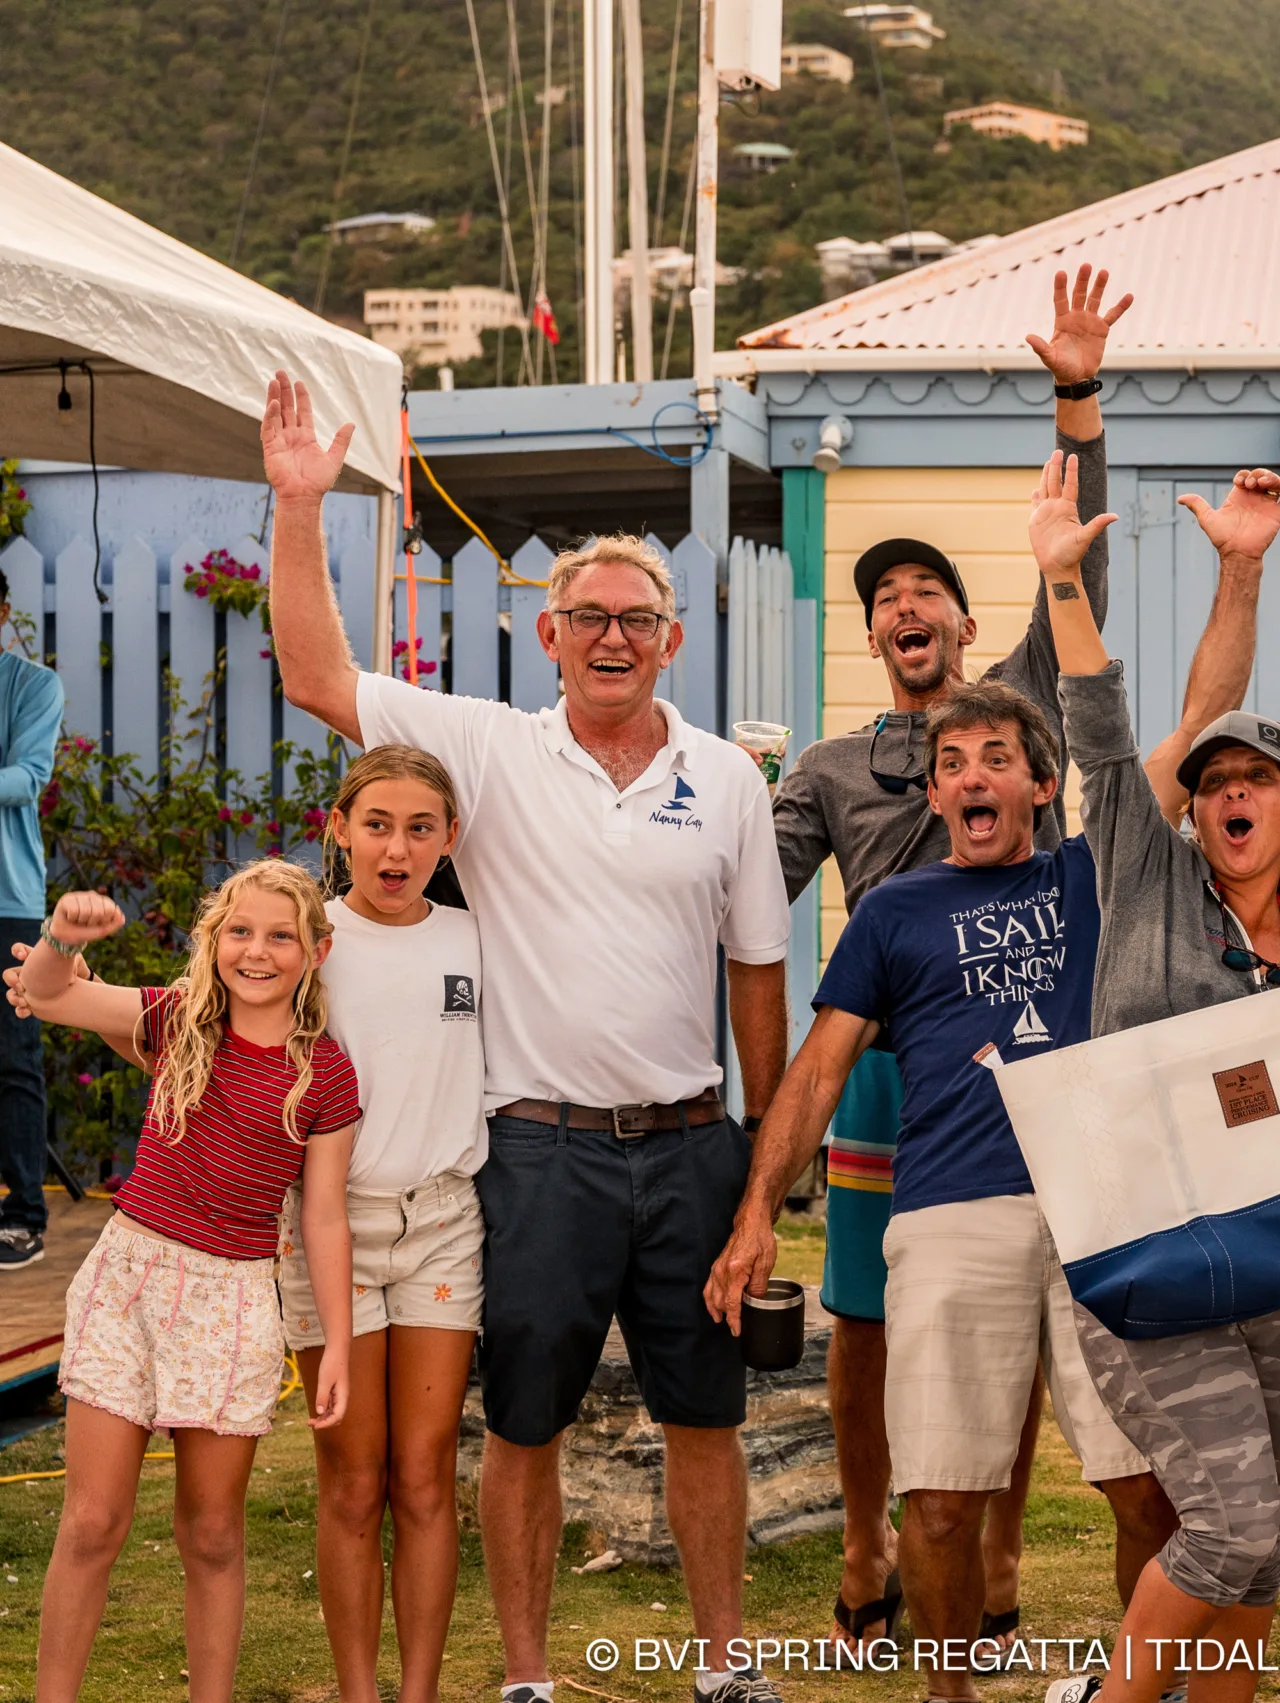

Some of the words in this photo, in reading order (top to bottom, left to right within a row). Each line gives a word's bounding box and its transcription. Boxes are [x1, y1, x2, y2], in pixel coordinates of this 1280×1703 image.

[649, 809, 682, 830] Nanny
[685, 814, 702, 832] Cay
[949, 901, 995, 923] THAT'S
[997, 896, 1035, 912] WHAT
[953, 923, 970, 956] I
[976, 902, 1066, 949] SAIL
[1006, 945, 1036, 959] AND
[962, 971, 973, 996] I
[1243, 1094, 1267, 1105] PLACE
[1232, 1105, 1270, 1120] CRUISING
